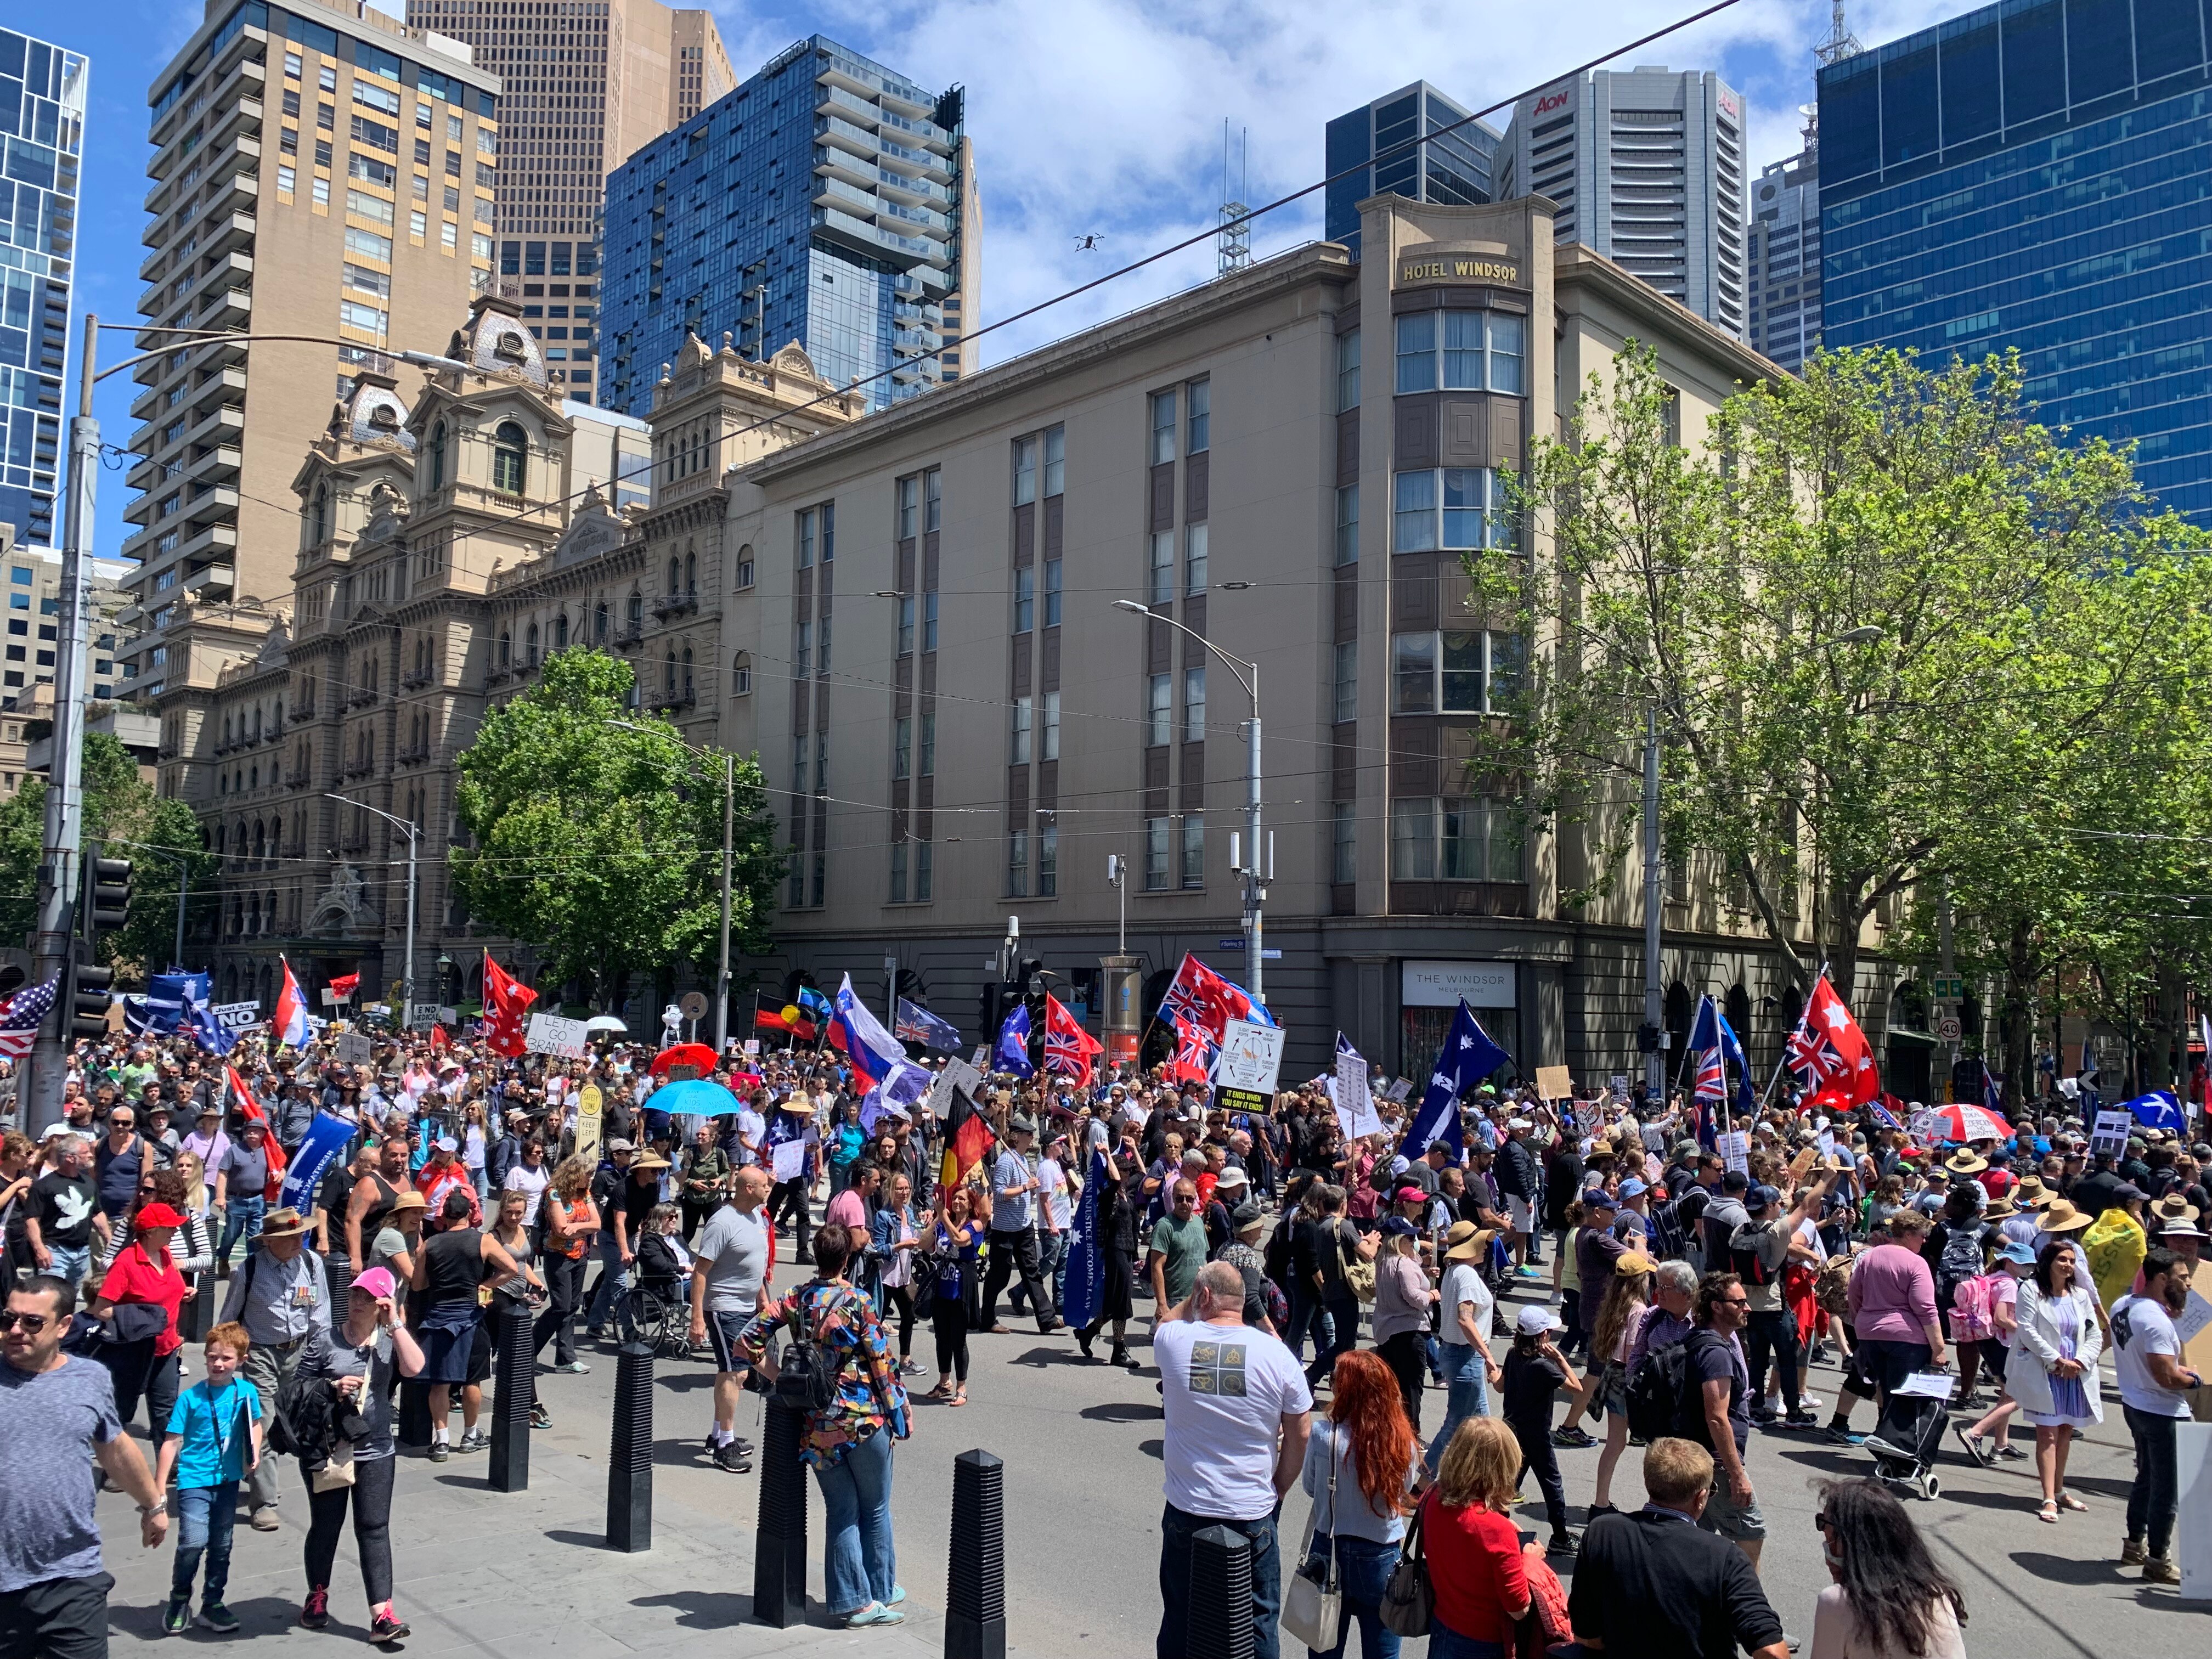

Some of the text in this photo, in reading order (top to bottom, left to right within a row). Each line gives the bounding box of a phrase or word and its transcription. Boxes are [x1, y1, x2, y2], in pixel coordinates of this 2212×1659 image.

[1533, 91, 1568, 116] AON
[1404, 262, 1516, 281] HOTEL WINDSOR
[569, 531, 608, 554] WINDSOR
[1417, 974, 1504, 985] THE WINDSOR
[218, 1011, 255, 1027] NO
[545, 1016, 578, 1031] LETS
[549, 1029, 567, 1041] GO
[1943, 1025, 1957, 1034] 40
[527, 1038, 584, 1058] BRANDAN
[584, 1093, 598, 1102] SAFETY
[931, 1085, 944, 1104] LINDA
[1232, 1091, 1246, 1099] ENDS
[1246, 1093, 1261, 1102] WHEN
[585, 1102, 595, 1110] ZONE
[1222, 1098, 1232, 1107] YOU
[1232, 1099, 1243, 1108] SAY
[1249, 1102, 1264, 1111] ENDS!
[1575, 1102, 1588, 1110] STOP
[1085, 1194, 1093, 1240] INJUSTICE
[1084, 1289, 1093, 1310] LAW
